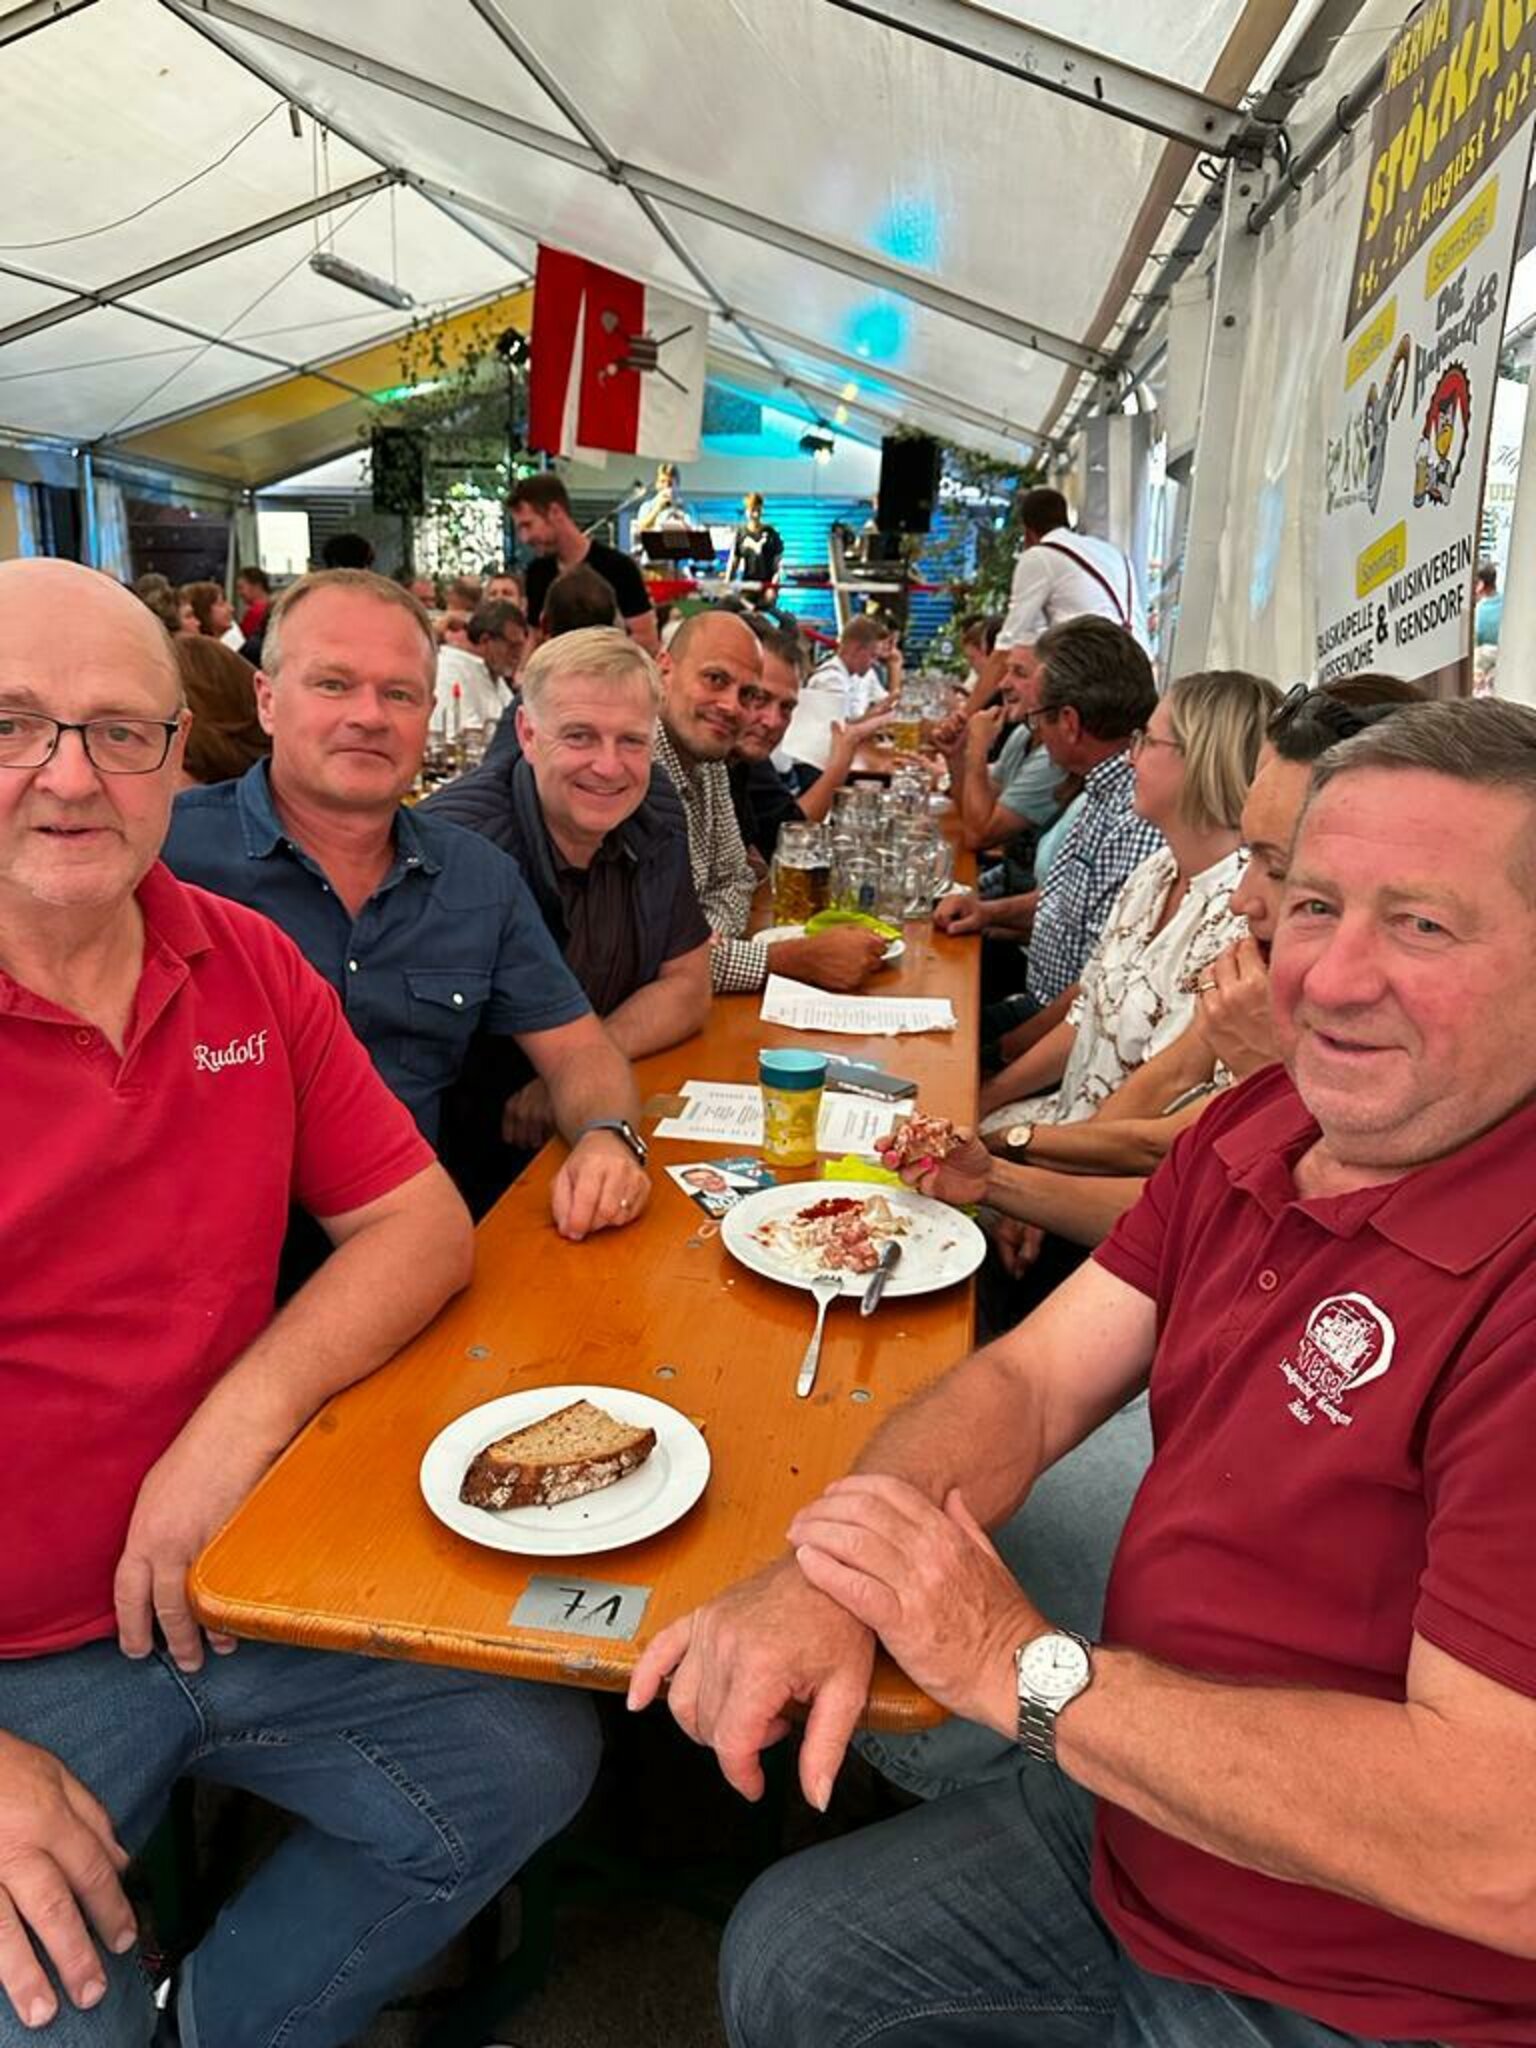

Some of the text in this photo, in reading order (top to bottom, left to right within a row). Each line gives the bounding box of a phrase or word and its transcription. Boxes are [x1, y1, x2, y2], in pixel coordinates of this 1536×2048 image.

[1418, 119, 1487, 232] August
[1491, 51, 1536, 142] 202
[1376, 604, 1389, 645] &
[1388, 533, 1472, 612] MUSIKVEREIN
[1394, 583, 1465, 647] IGENSDORF
[193, 1029, 267, 1073] Rudolf
